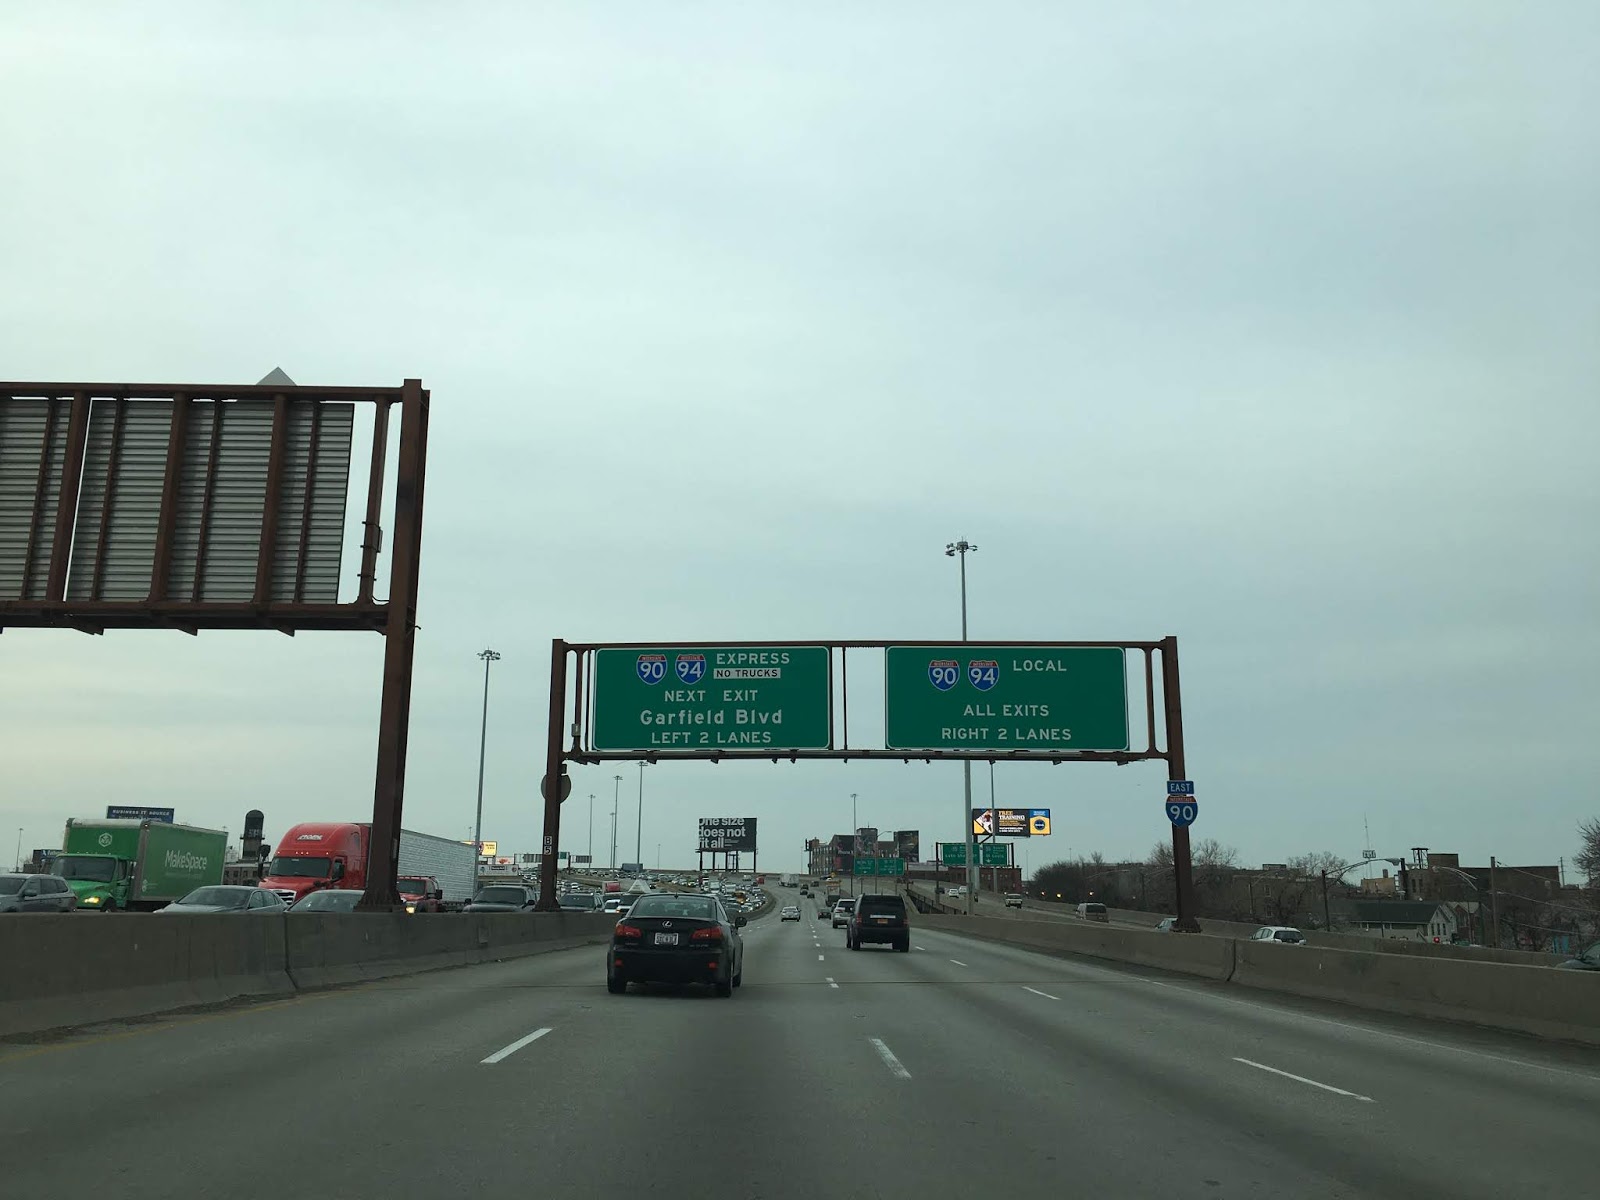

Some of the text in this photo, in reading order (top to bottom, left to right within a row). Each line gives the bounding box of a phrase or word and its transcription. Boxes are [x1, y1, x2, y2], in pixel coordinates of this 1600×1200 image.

[640, 652, 790, 679] 90 94 EXPRESS
[932, 659, 1068, 685] 90 94 LOCAL
[716, 669, 778, 678] NO TRUCKS
[664, 689, 758, 702] NEXT EXIT
[963, 704, 1050, 717] ALL EXITS
[640, 709, 782, 726] Garfield Blvd
[651, 731, 772, 744] LEFT 2 LANES
[941, 727, 1072, 741] RIGHT 2 LANES
[1170, 783, 1191, 792] EAST
[1170, 805, 1194, 821] 90
[721, 818, 745, 826] size
[726, 826, 746, 837] not
[700, 837, 710, 848] it
[711, 837, 724, 848] all
[544, 846, 551, 855] 5
[165, 849, 208, 872] MakeSpace
